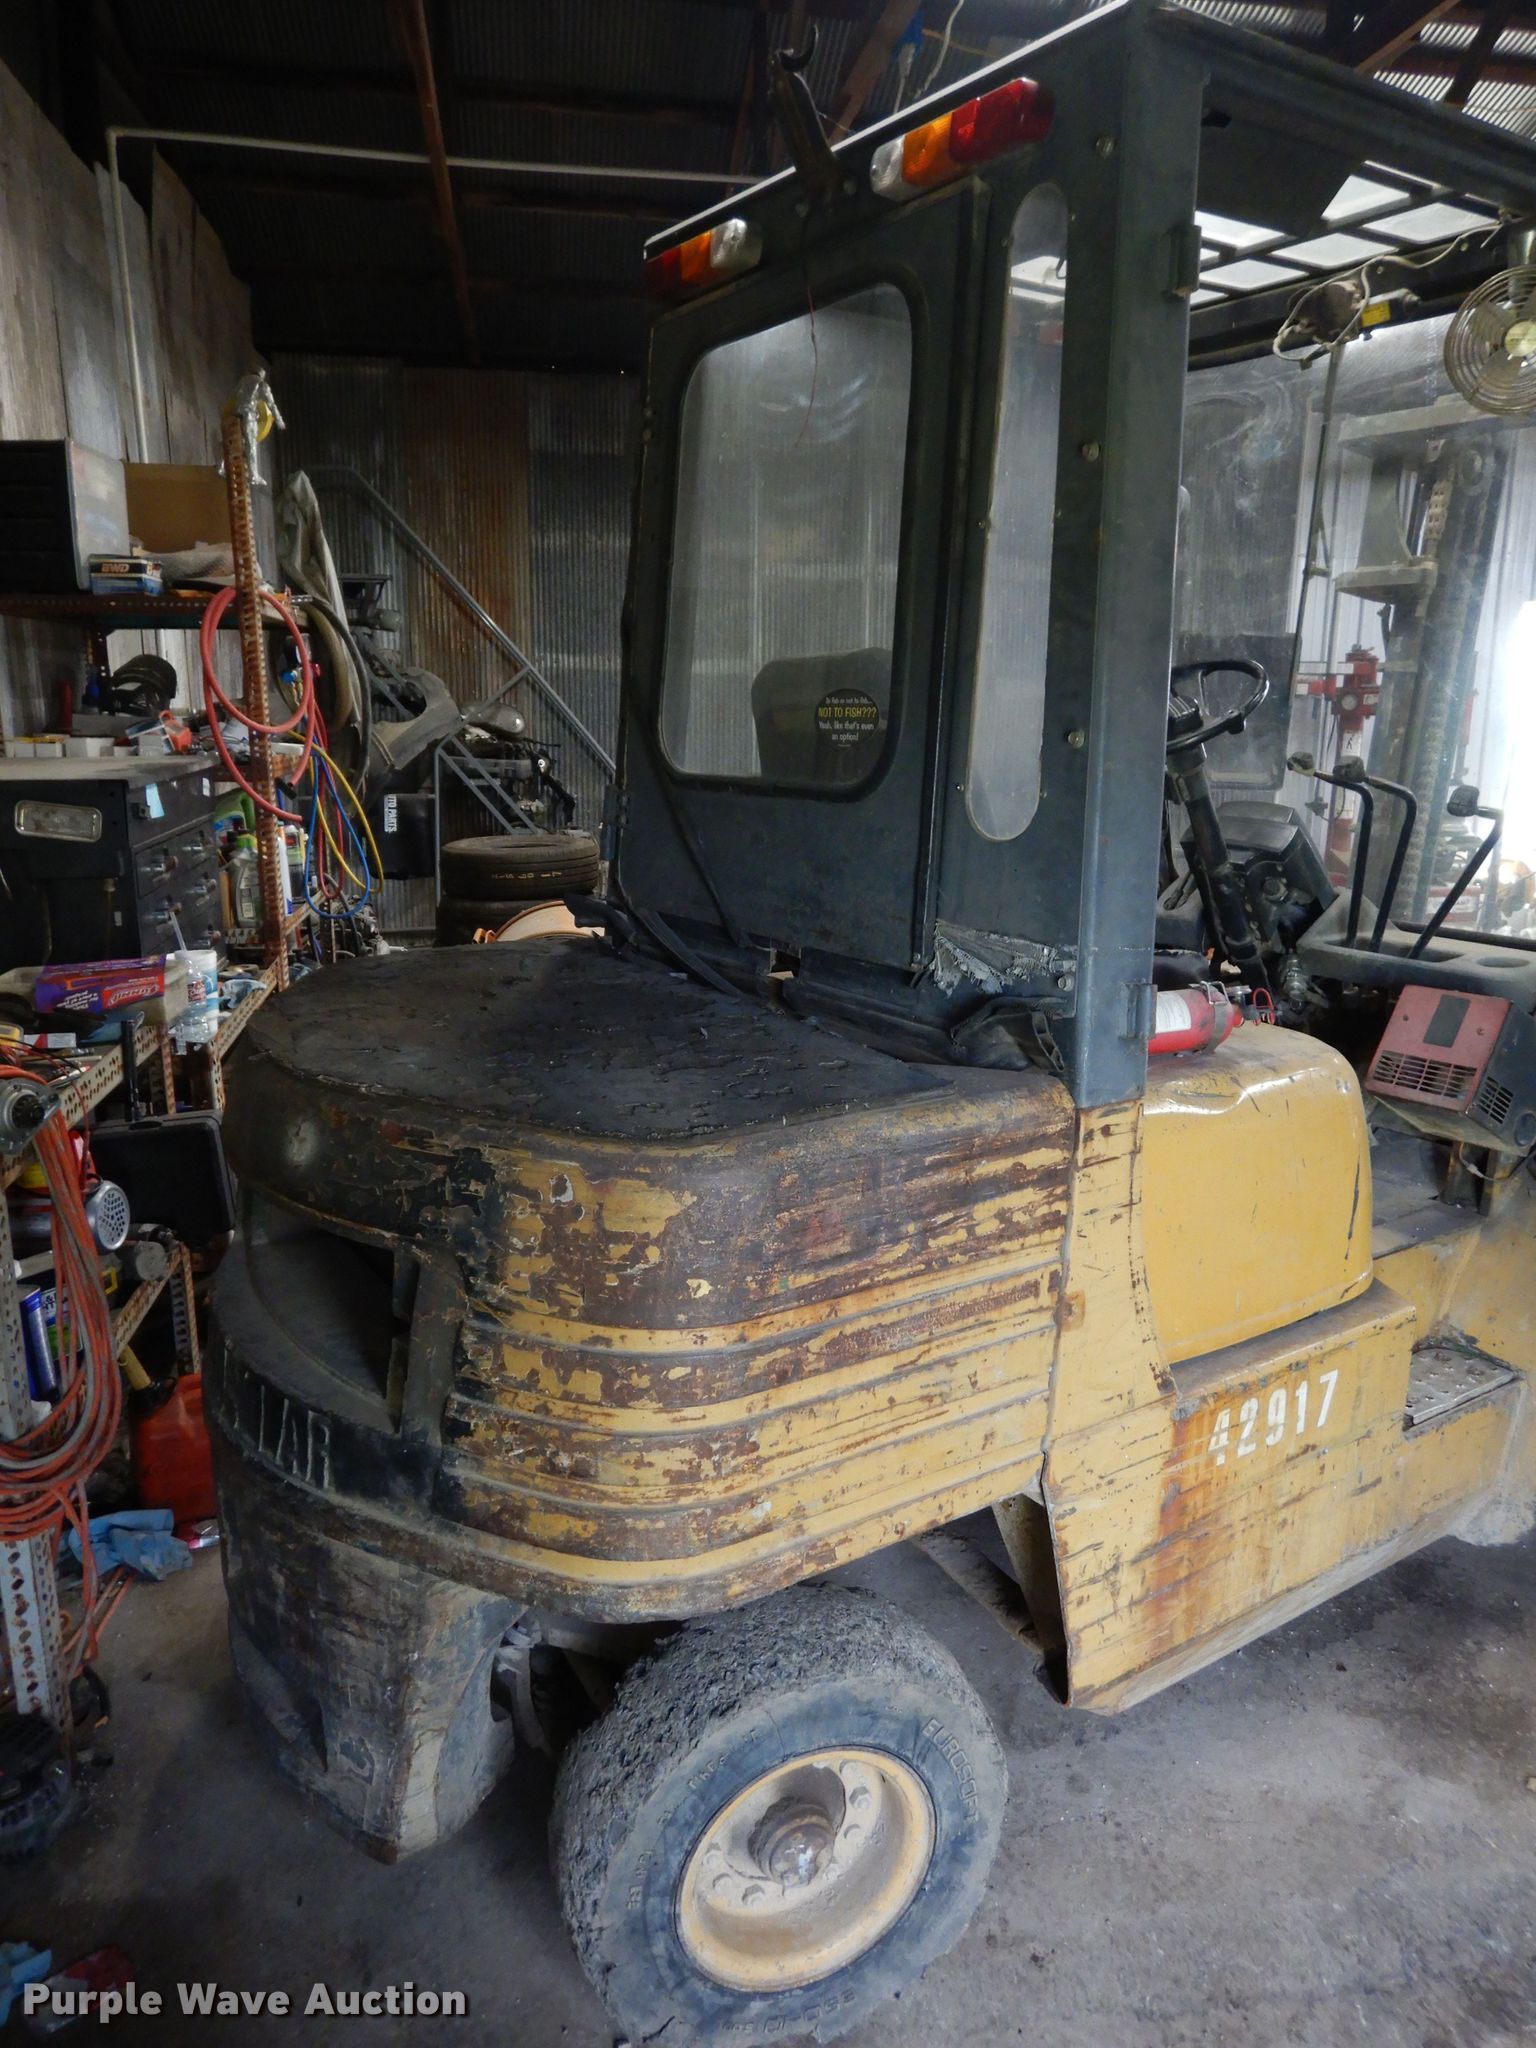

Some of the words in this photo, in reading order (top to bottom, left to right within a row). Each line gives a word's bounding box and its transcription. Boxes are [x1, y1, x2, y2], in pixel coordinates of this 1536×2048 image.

[818, 706, 831, 718] NOT
[834, 706, 843, 718] TO
[845, 706, 877, 719] FISH???
[1207, 1368, 1339, 1467] 42917
[922, 1716, 979, 1822] EUROSOFT
